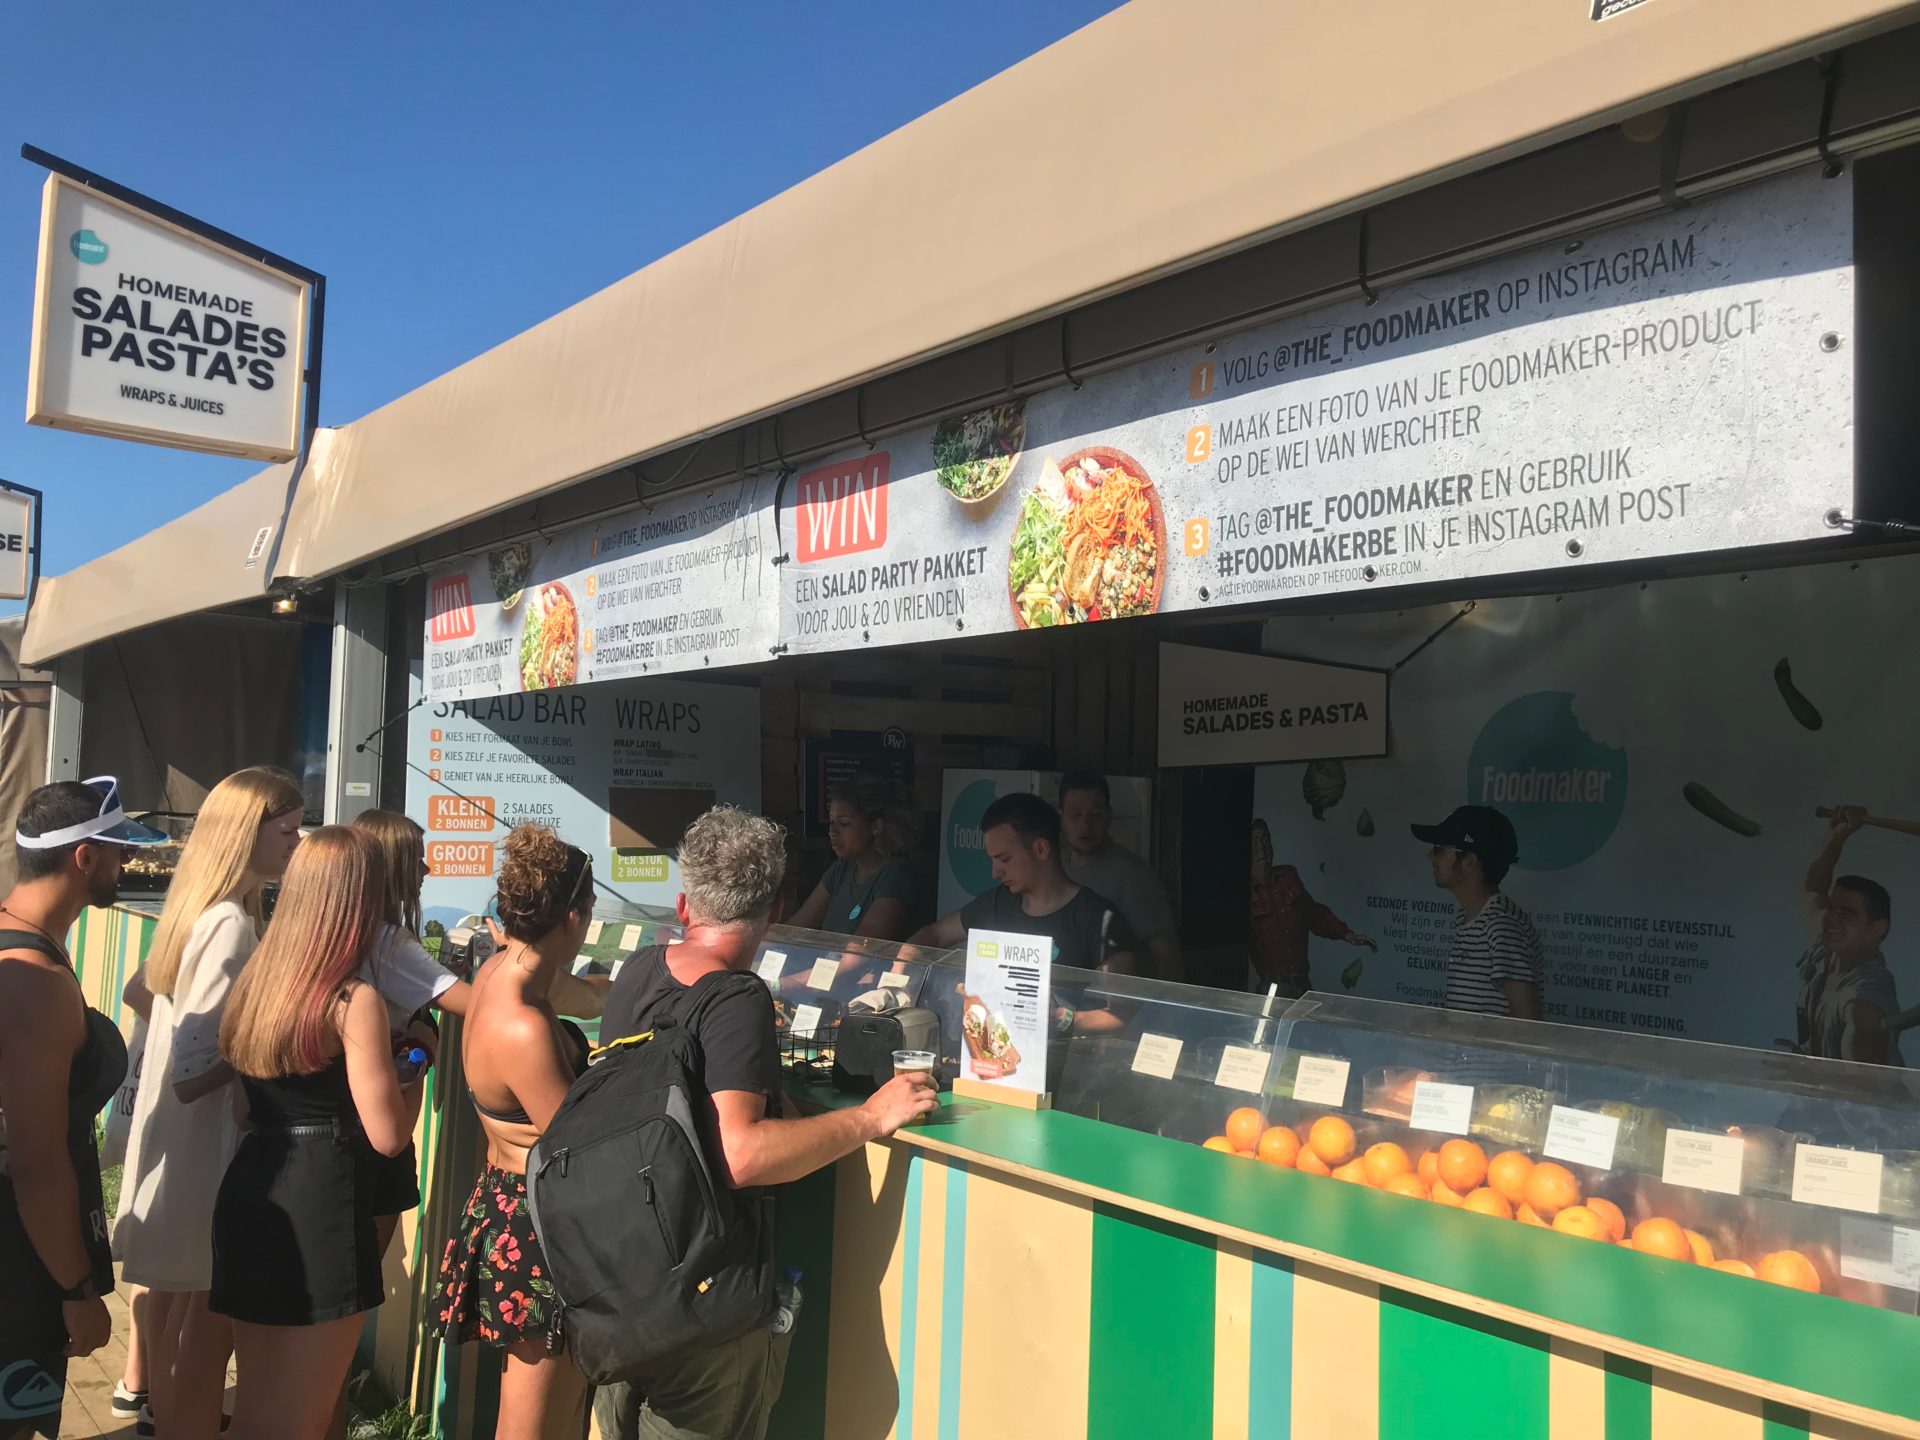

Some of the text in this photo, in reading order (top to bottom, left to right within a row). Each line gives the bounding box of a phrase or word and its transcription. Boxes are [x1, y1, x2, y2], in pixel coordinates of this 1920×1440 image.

[118, 272, 253, 317] HOMEMADE
[71, 287, 287, 358] SALADES
[1199, 234, 1696, 392] 1 VOLG @THE_FOODMAKER OP INSTAGRAM
[81, 324, 275, 390] PASTA'S
[1193, 299, 1763, 457] 2 MAAK EEN FOTO VAN JE FOODMAKER-PRODUCT
[119, 383, 224, 415] WRAPS & JUICES
[1218, 404, 1481, 484] OP DE WEI VAN WERCHTER
[806, 467, 878, 553] WIN
[1192, 446, 1632, 550] 3 TAG @THE_FOODMAKER EN GEBRUIK
[616, 500, 740, 549] @THE_FOODMAKER INSTAGRAM
[1217, 483, 1691, 578] #FOODMAKERBE IN JE INSTAGRAM POST
[598, 536, 758, 589] MAAK EEN FOTO VAN JE FOODMAKER-PRODUCT
[796, 546, 987, 603] EEN SALAD PARTY PAKKET
[1218, 560, 1422, 599] ACTIEVOORWAARDEN OP THEFOODAKER.COM
[435, 582, 470, 636] WIN
[597, 578, 682, 610] OP DE WEI VAN WERCHTER
[596, 607, 724, 645] TAG @THE_FOODMAKER EN GEBRUIK
[796, 588, 965, 635] VOOR JOU & 20 VRIENDEN
[485, 638, 513, 659] PAKKET
[596, 628, 740, 666] #FOODMAKERBE IN JE INSTAGRAM POST
[433, 692, 587, 726] SALAD BAR
[615, 698, 701, 734] WRAPS
[1184, 694, 1268, 714] HOMEMADE
[1184, 702, 1368, 735] SALADES & PASTA
[445, 731, 464, 742] KIES
[466, 732, 482, 743] HET
[483, 733, 520, 744] FORMAAT
[523, 735, 539, 746] VAN
[540, 736, 550, 746] JE
[552, 737, 573, 747] BOWL
[613, 738, 662, 750] WRAP LATINO
[445, 751, 463, 761] KIES
[465, 751, 484, 762] ZELF
[486, 752, 497, 763] JE
[498, 753, 538, 764] FAVORIETE
[542, 755, 576, 766] SALADES
[613, 768, 663, 778] WRAP ITALIAN
[444, 771, 473, 781] GENIET
[475, 772, 492, 782] VAN
[494, 772, 504, 783] JE
[506, 773, 548, 784] HEERLIJKE
[550, 774, 574, 785] BOWL!
[1481, 766, 1611, 803] Foodmaker
[435, 818, 487, 829] 2 BONNEN
[438, 799, 487, 817] KLEIN
[503, 802, 553, 815] 2 SALADES
[433, 844, 488, 862] GROOT
[434, 863, 486, 874] 3 BONNEN
[618, 855, 662, 865] PER STUK
[618, 867, 662, 877] 2 BONNEN
[1367, 896, 1737, 939] GEZONDE VOEDING een EVENWICHTIGE LEVENSSTIJL.
[1391, 912, 1408, 928] Wij
[1411, 915, 1430, 929] zijn
[1434, 919, 1446, 928] er
[1551, 929, 1574, 940] van
[1577, 931, 1643, 949] overtuigd
[1647, 934, 1671, 949] dat
[1674, 940, 1698, 952] wie
[1004, 944, 1040, 964] WRAPS
[1383, 925, 1710, 970] kiest voor en een duurzame
[1552, 973, 1613, 992] SCHONERE
[1558, 961, 1588, 973] voor
[1592, 965, 1617, 976] een
[1621, 964, 1670, 982] LANGER
[1673, 973, 1692, 984] en
[1397, 982, 1447, 999] Foodmak
[1575, 1005, 1627, 1025] LEKKERE
